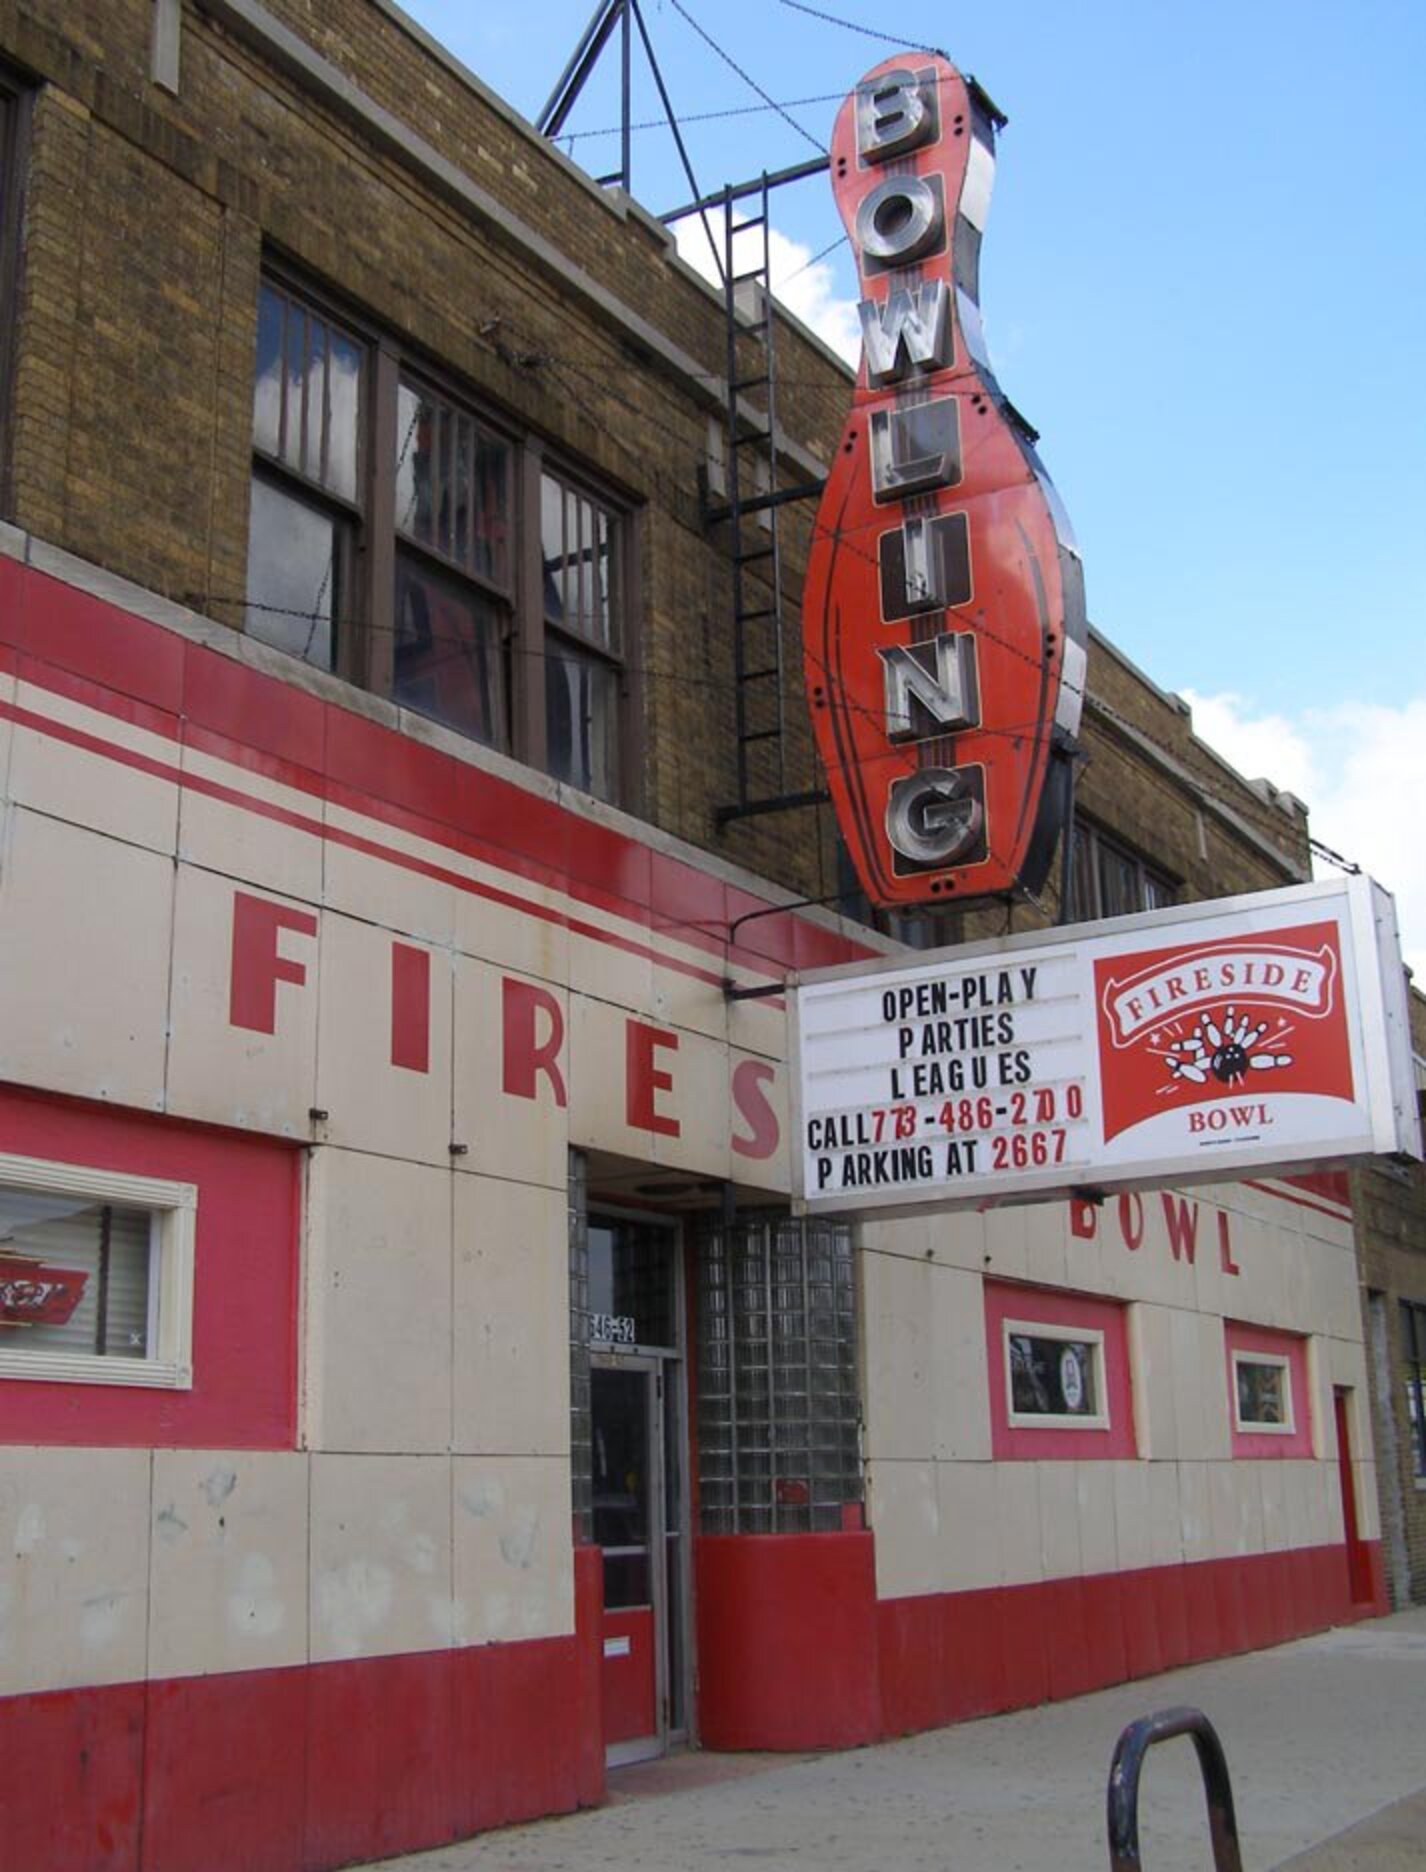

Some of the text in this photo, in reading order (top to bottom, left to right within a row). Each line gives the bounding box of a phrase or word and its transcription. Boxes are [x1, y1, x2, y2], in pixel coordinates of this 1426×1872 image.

[856, 68, 982, 866] BOWLING
[883, 967, 1037, 1022] OPEN-PLAY
[1126, 962, 1312, 1021] FIRESIDE
[899, 1012, 1014, 1059] PARTIES
[891, 1050, 1031, 1100] LEAGUES
[1188, 1103, 1275, 1133] BOWL
[818, 1128, 1066, 1189] PARKING AT 2667
[1070, 1190, 1240, 1276] BOWL
